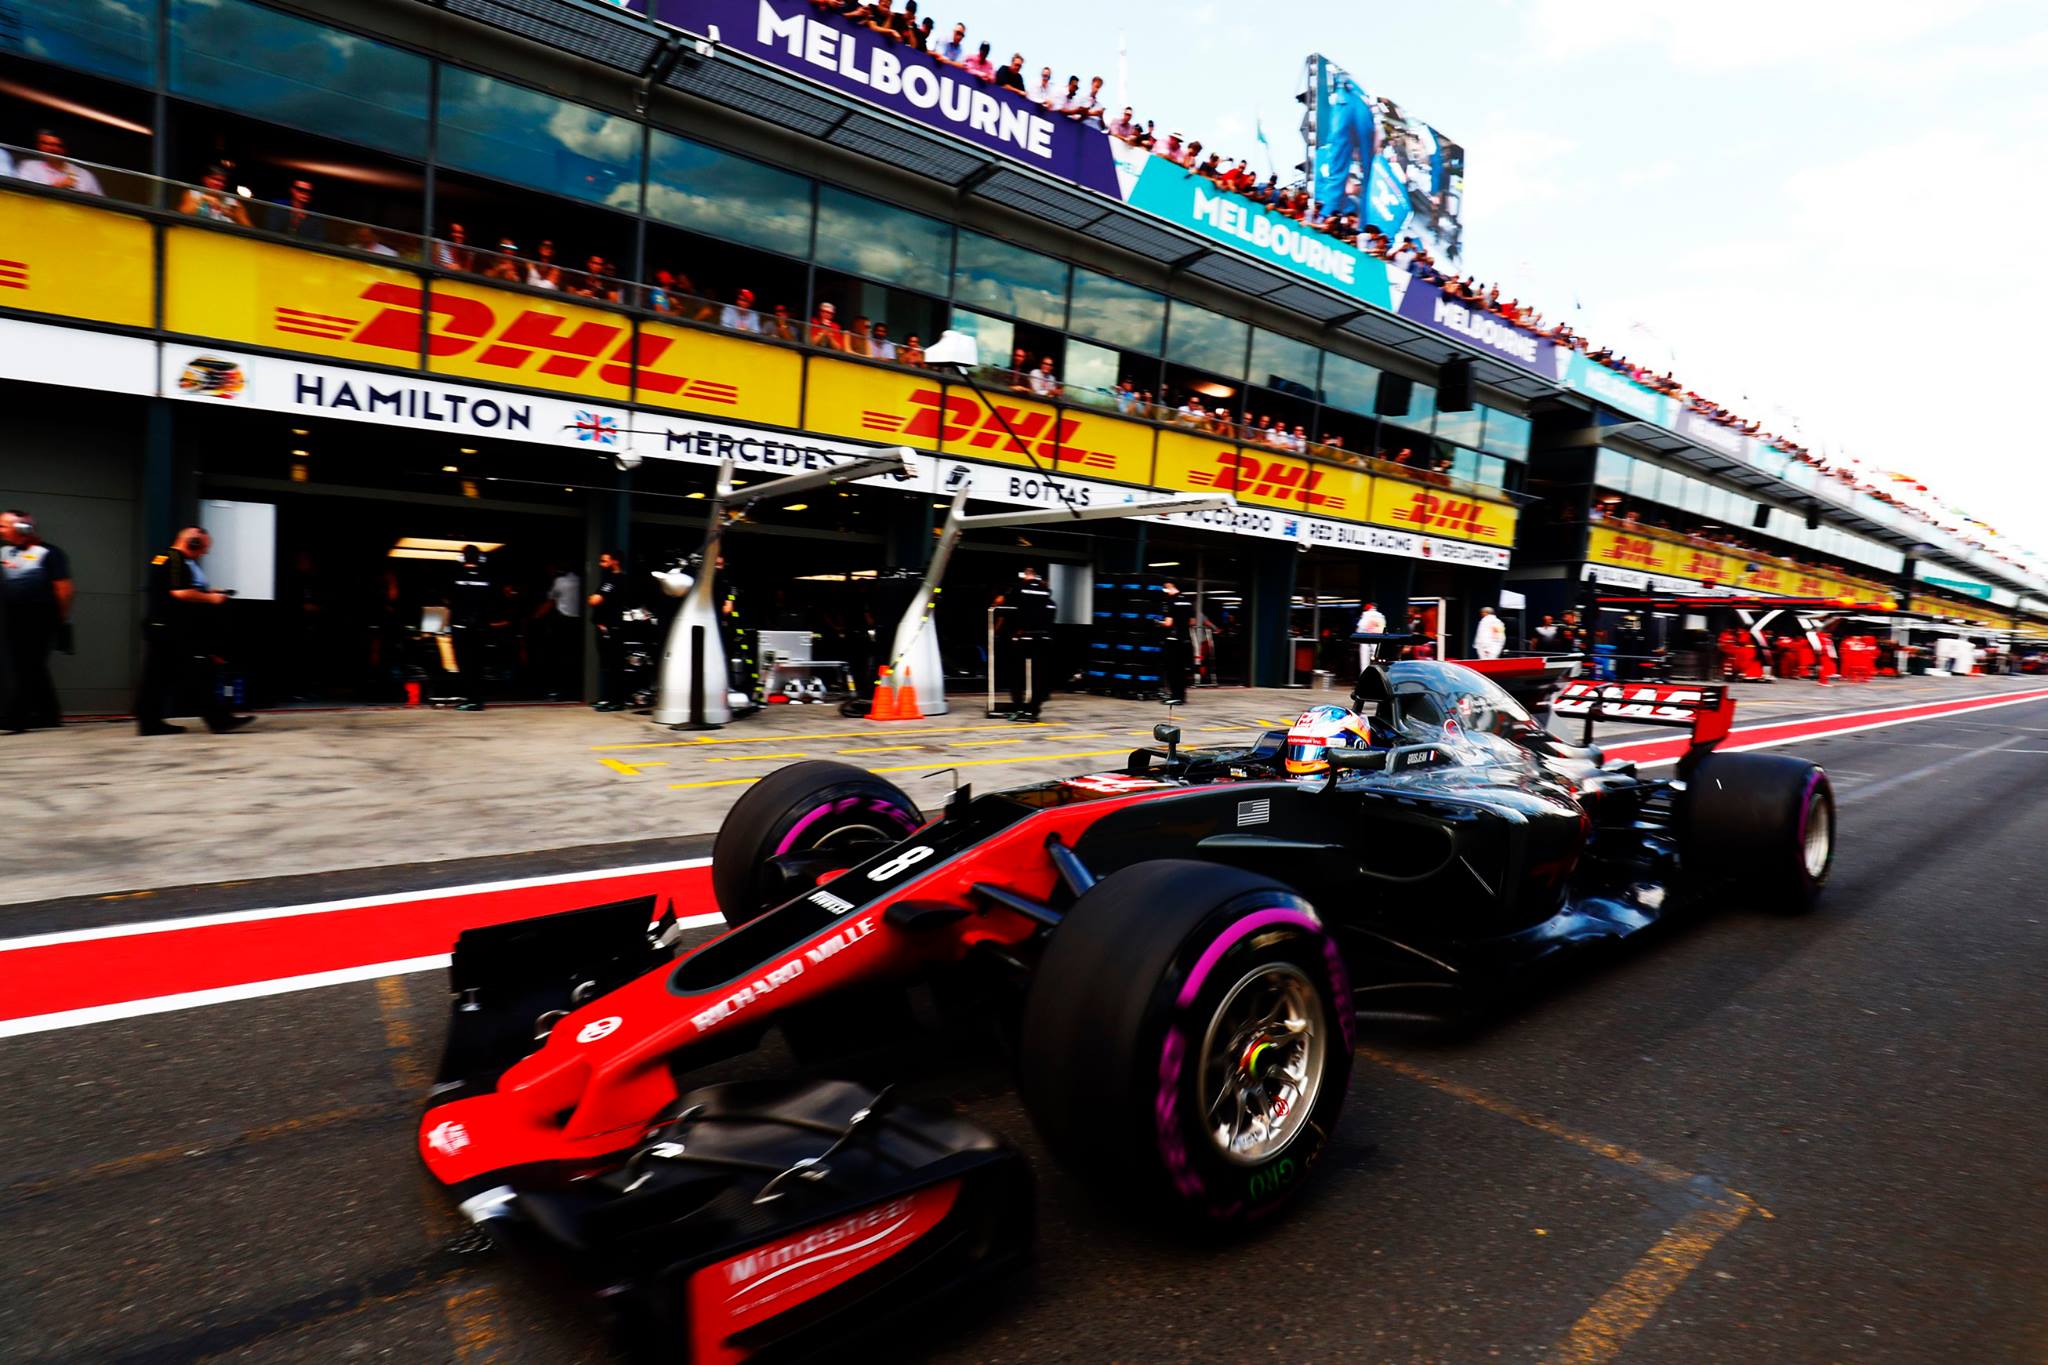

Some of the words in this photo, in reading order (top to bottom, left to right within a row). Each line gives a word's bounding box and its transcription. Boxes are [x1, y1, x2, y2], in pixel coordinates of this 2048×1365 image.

[756, 0, 1055, 158] MELBOURNE
[1193, 187, 1357, 284] MELBOURNE
[352, 282, 689, 394] DHL
[1434, 297, 1538, 362] MELBOURNE
[295, 373, 531, 431] HAMILTON
[901, 388, 1089, 464] DHL
[1009, 476, 1091, 506] BOTTAS
[1212, 452, 1328, 506] DHL
[1309, 522, 1333, 541] RED
[1338, 527, 1366, 546] BULL
[1371, 533, 1413, 551] RACING
[1408, 492, 1484, 534] DHL
[867, 846, 935, 882] 8
[690, 958, 805, 1032] RICHARD
[805, 917, 877, 965] MILLE
